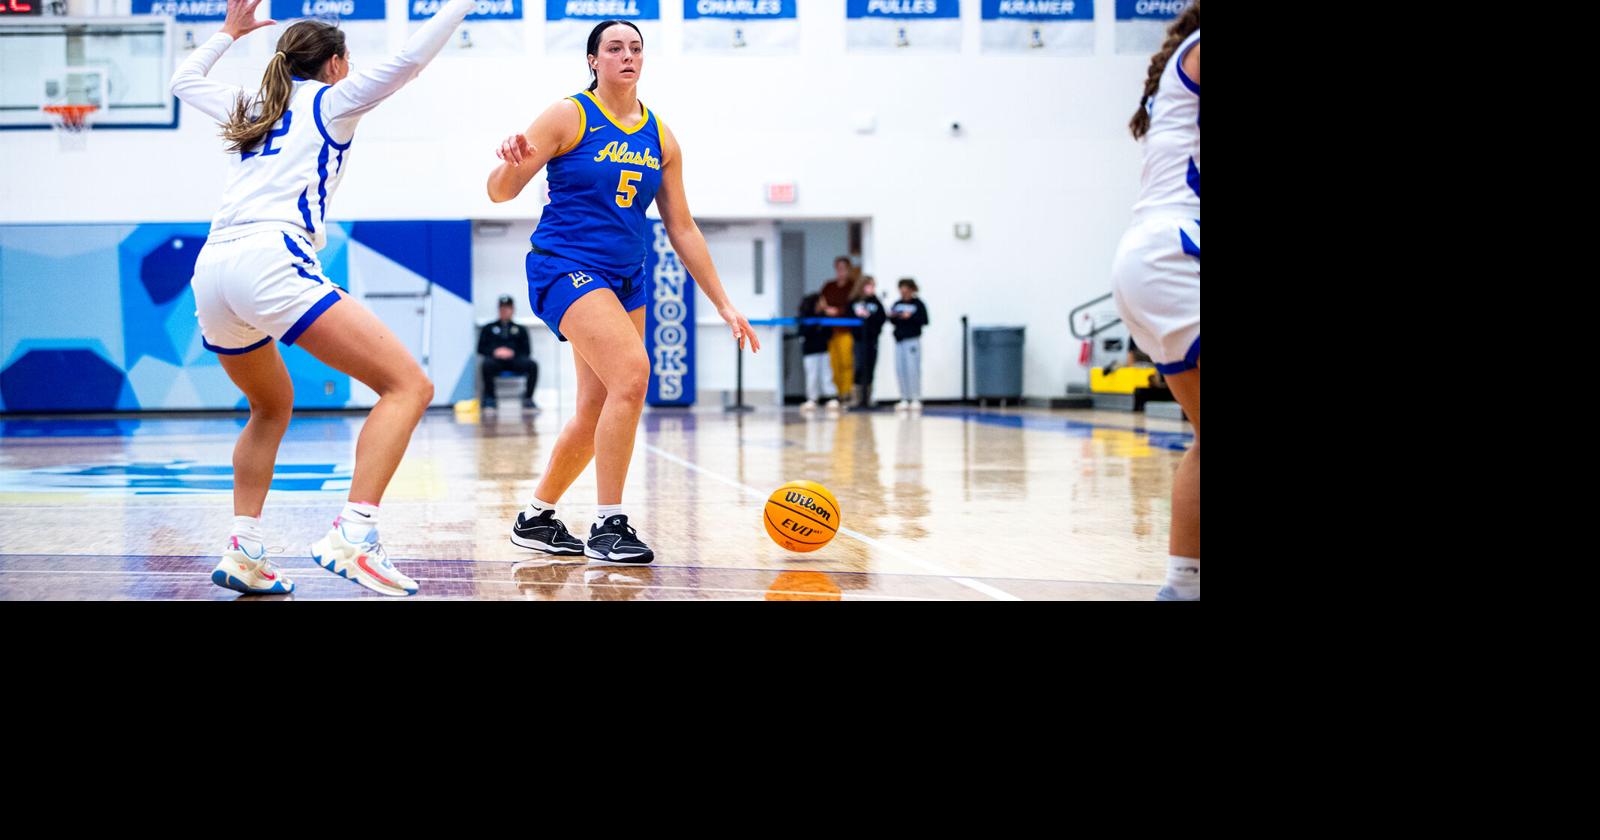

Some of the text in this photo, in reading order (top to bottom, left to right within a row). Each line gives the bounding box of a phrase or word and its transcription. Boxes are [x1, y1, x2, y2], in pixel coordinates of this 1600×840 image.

[302, 0, 355, 15] LONG
[565, 0, 640, 16] KISSELL
[697, 0, 781, 15] CHARLES
[867, 0, 937, 14] PULLES
[999, 0, 1075, 15] KRAMER
[593, 141, 660, 170] Alaska
[615, 169, 643, 208] 5
[784, 491, 831, 521] Wilson
[781, 518, 814, 537] EVO
